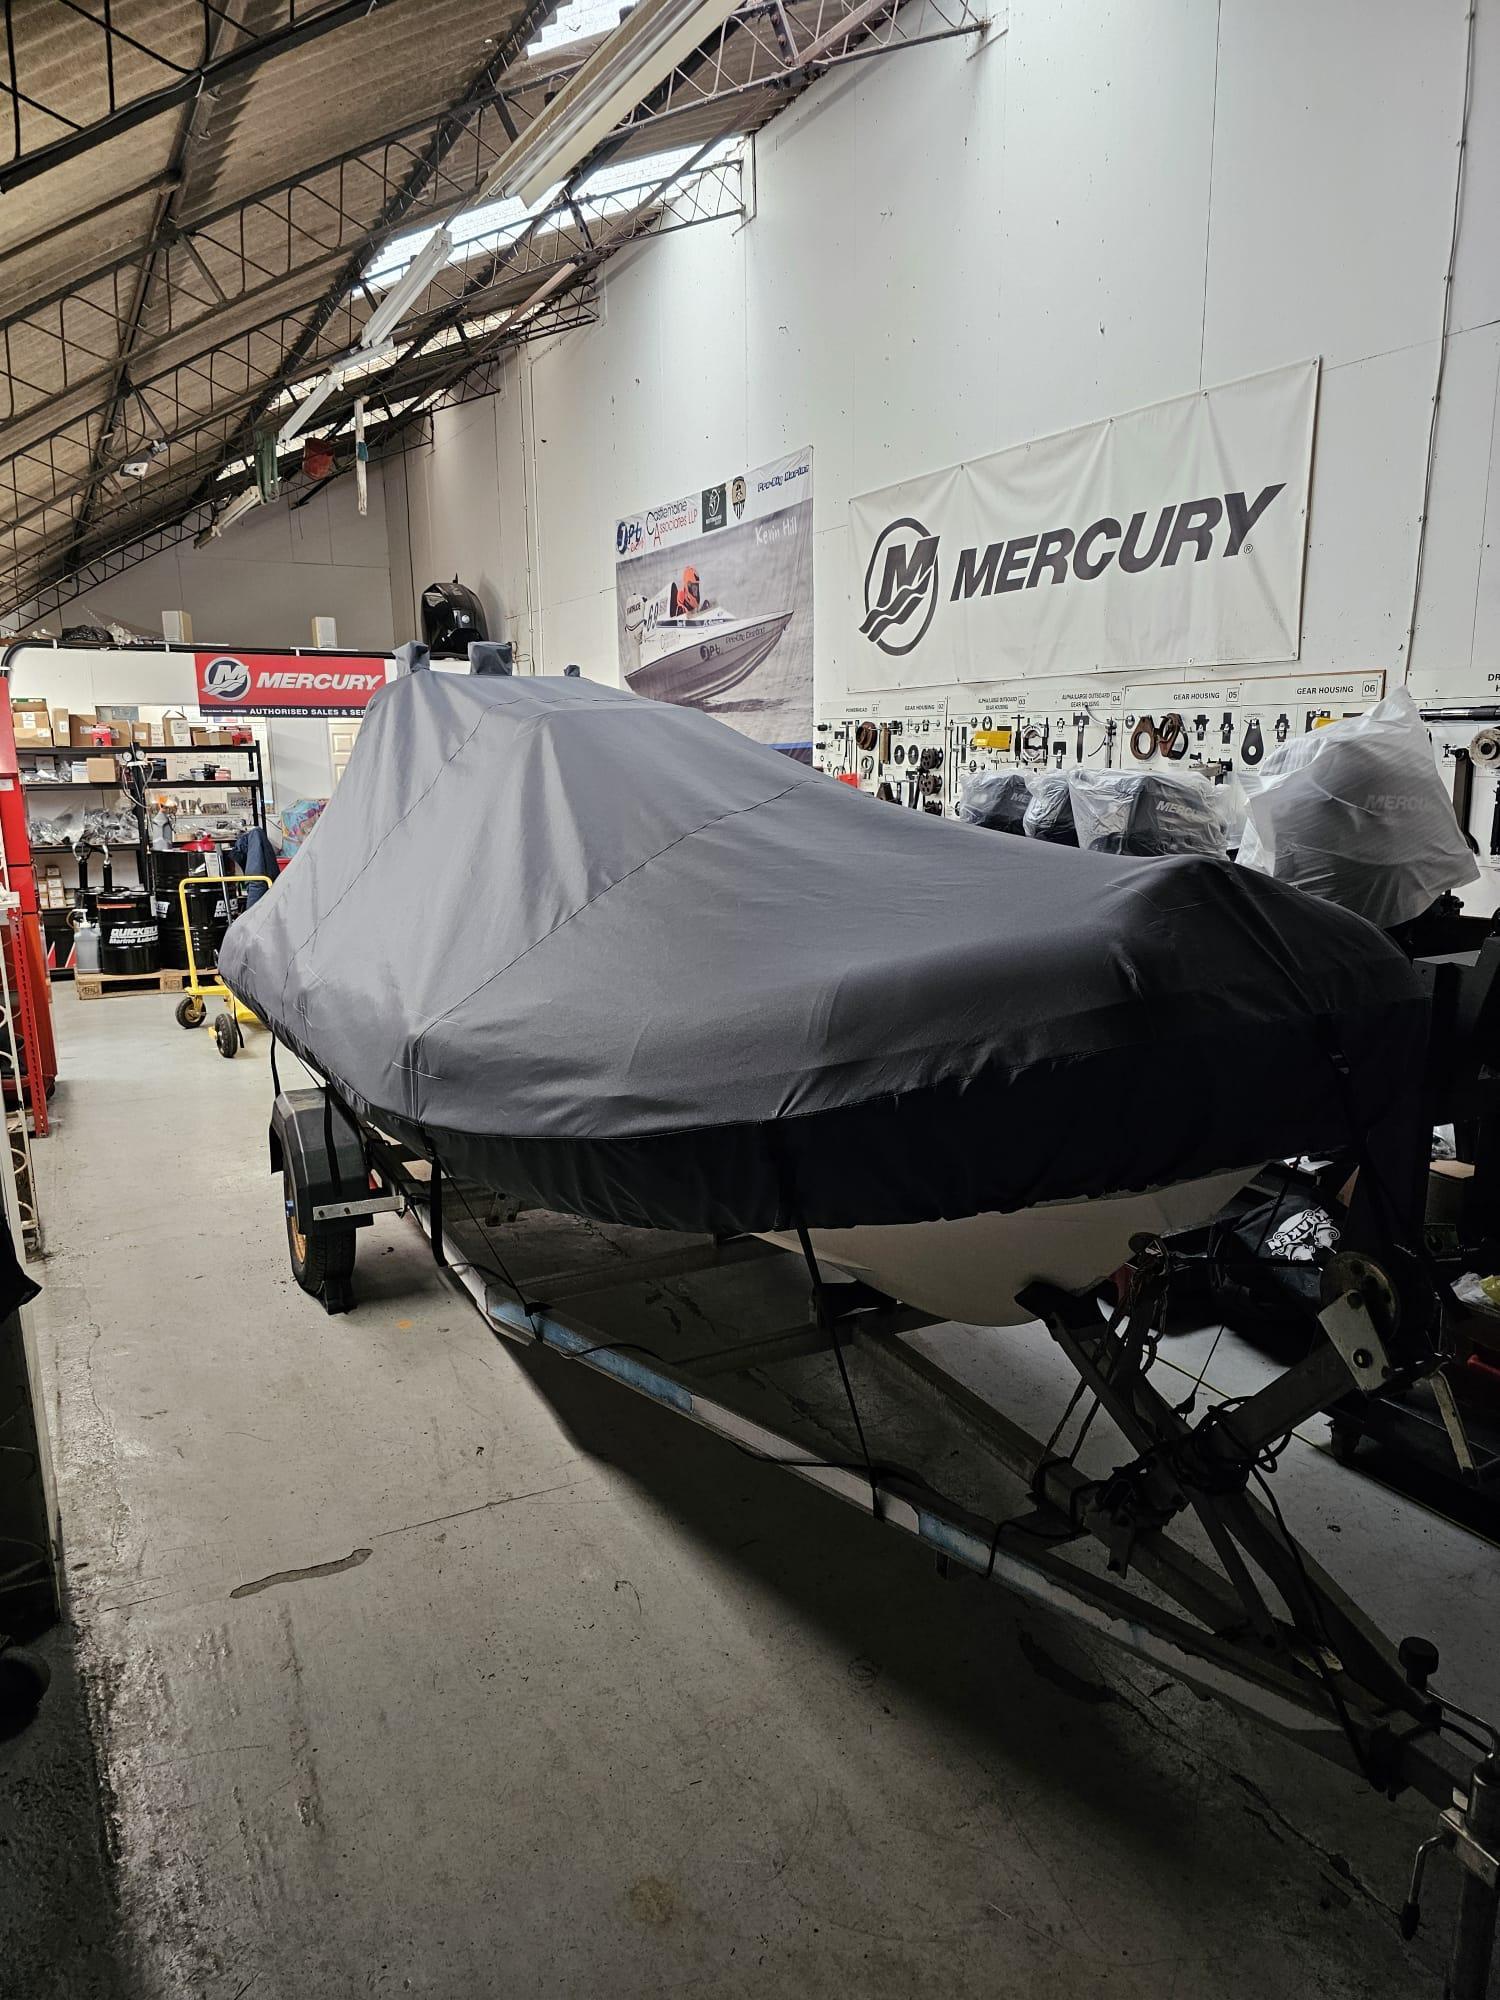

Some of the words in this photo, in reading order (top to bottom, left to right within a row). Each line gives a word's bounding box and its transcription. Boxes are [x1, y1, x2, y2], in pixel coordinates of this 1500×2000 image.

[782, 516, 798, 536] Hill
[950, 483, 1287, 602] MERCURY
[257, 672, 383, 690] MERCURY
[1296, 687, 1317, 695] GEAR
[1318, 685, 1354, 694] HOUSING
[1364, 682, 1376, 693] 06
[1191, 692, 1220, 700] HOUSING
[1228, 690, 1238, 699] 05
[249, 707, 309, 716] AUTHORISED
[311, 708, 339, 717] SALES
[341, 709, 348, 717] &
